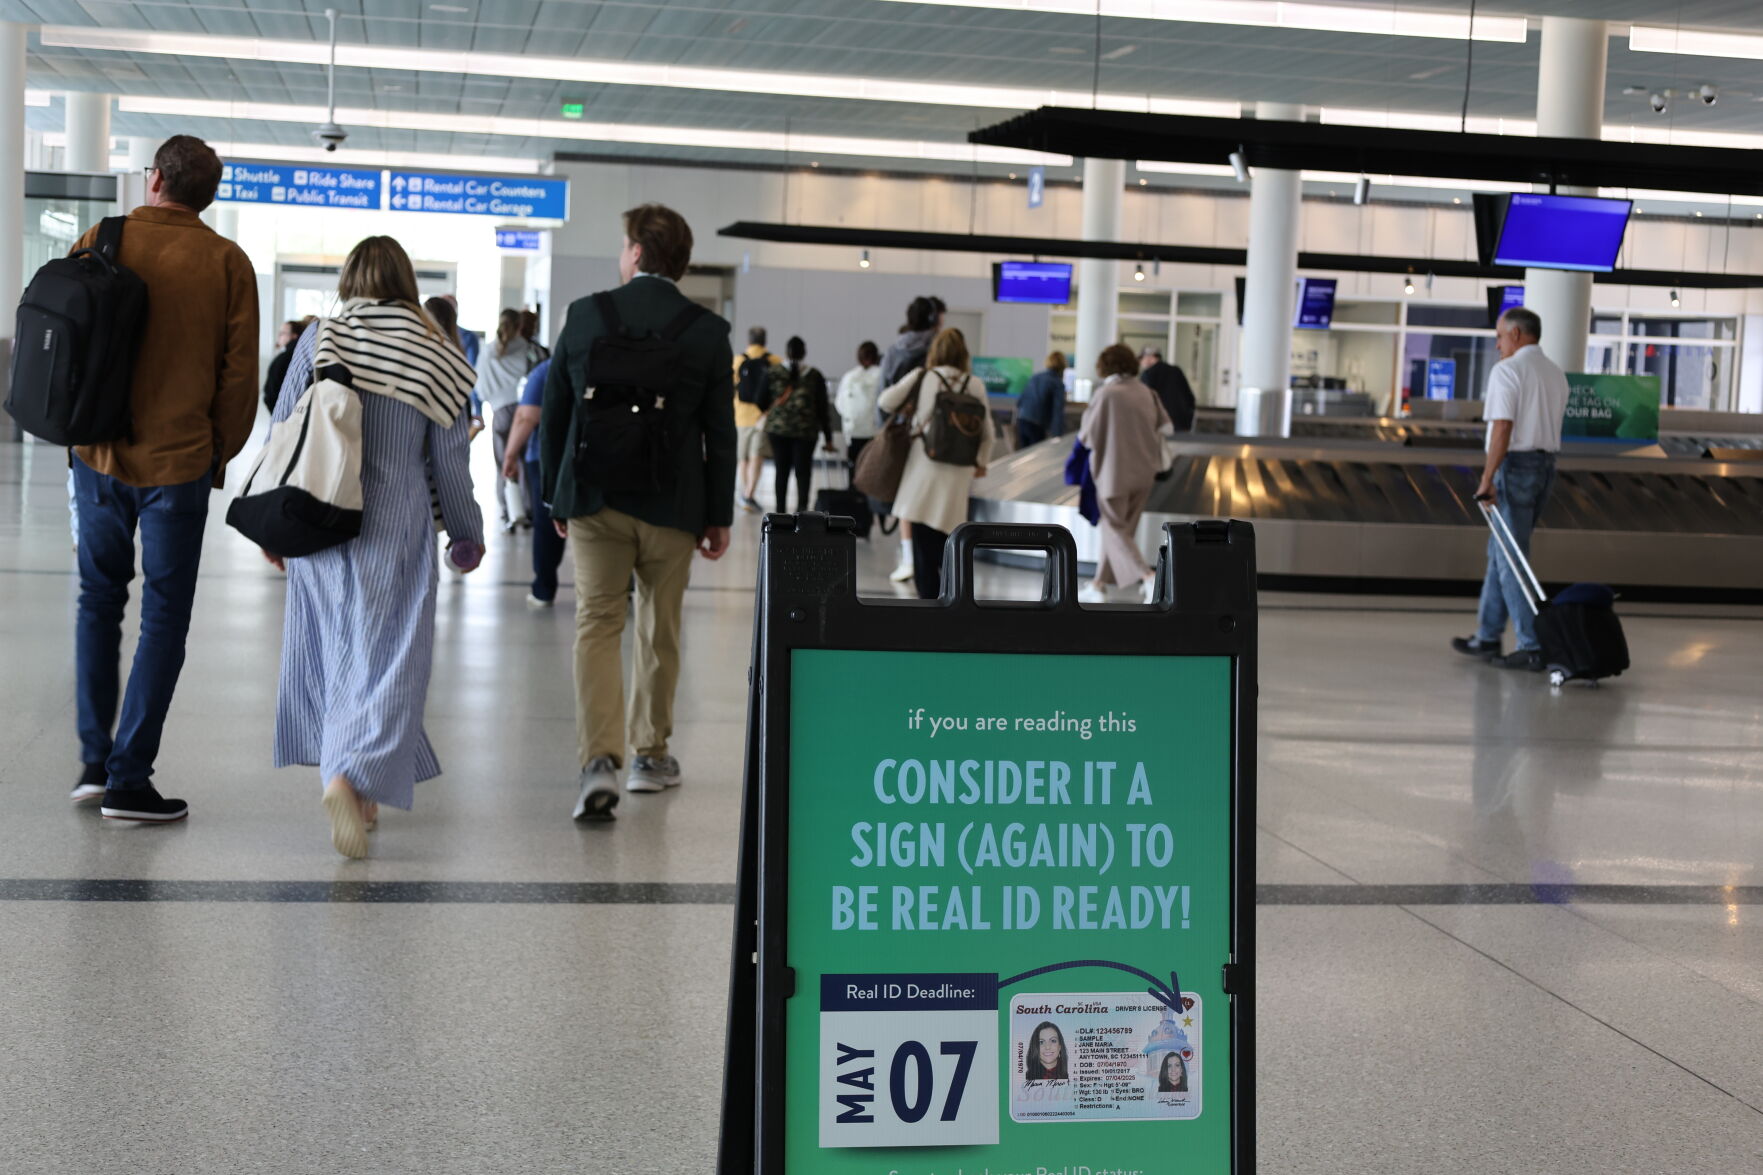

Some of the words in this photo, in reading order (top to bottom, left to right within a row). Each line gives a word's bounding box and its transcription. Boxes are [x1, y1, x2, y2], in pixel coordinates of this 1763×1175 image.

[234, 166, 281, 184] Shuttle
[309, 171, 338, 188] Ride
[340, 173, 376, 190] Share
[234, 184, 259, 200] Taxi
[287, 187, 326, 205] Public
[327, 189, 370, 207] Transit
[423, 178, 464, 195] Rental
[465, 180, 489, 196] Car
[490, 181, 547, 199] Counters
[423, 195, 464, 212] Rental
[465, 197, 488, 213] Car
[489, 198, 534, 218] Garage
[1569, 384, 1596, 396] HECK
[1590, 407, 1613, 419] BAG
[908, 708, 925, 731] if
[929, 715, 968, 738] you
[975, 717, 1008, 731] are
[1014, 710, 1093, 740] reading
[1098, 711, 1137, 733] this
[873, 758, 1072, 805] CONSIDER
[1084, 761, 1117, 805] IT
[1126, 761, 1153, 806] A
[850, 821, 946, 868] SIGN
[957, 821, 1115, 876] (AGAIN)
[1126, 823, 1174, 868] TO
[831, 885, 879, 931] BE
[892, 885, 991, 930] REAL
[1002, 885, 1041, 930] ID
[1053, 885, 1191, 930] READY!
[846, 984, 878, 999] Real
[883, 984, 902, 999] ID
[907, 983, 976, 999] Deadline:
[1016, 1004, 1053, 1015] South
[1055, 1004, 1109, 1014] Carolina
[835, 1042, 875, 1124] MAY
[889, 1040, 979, 1124] 07
